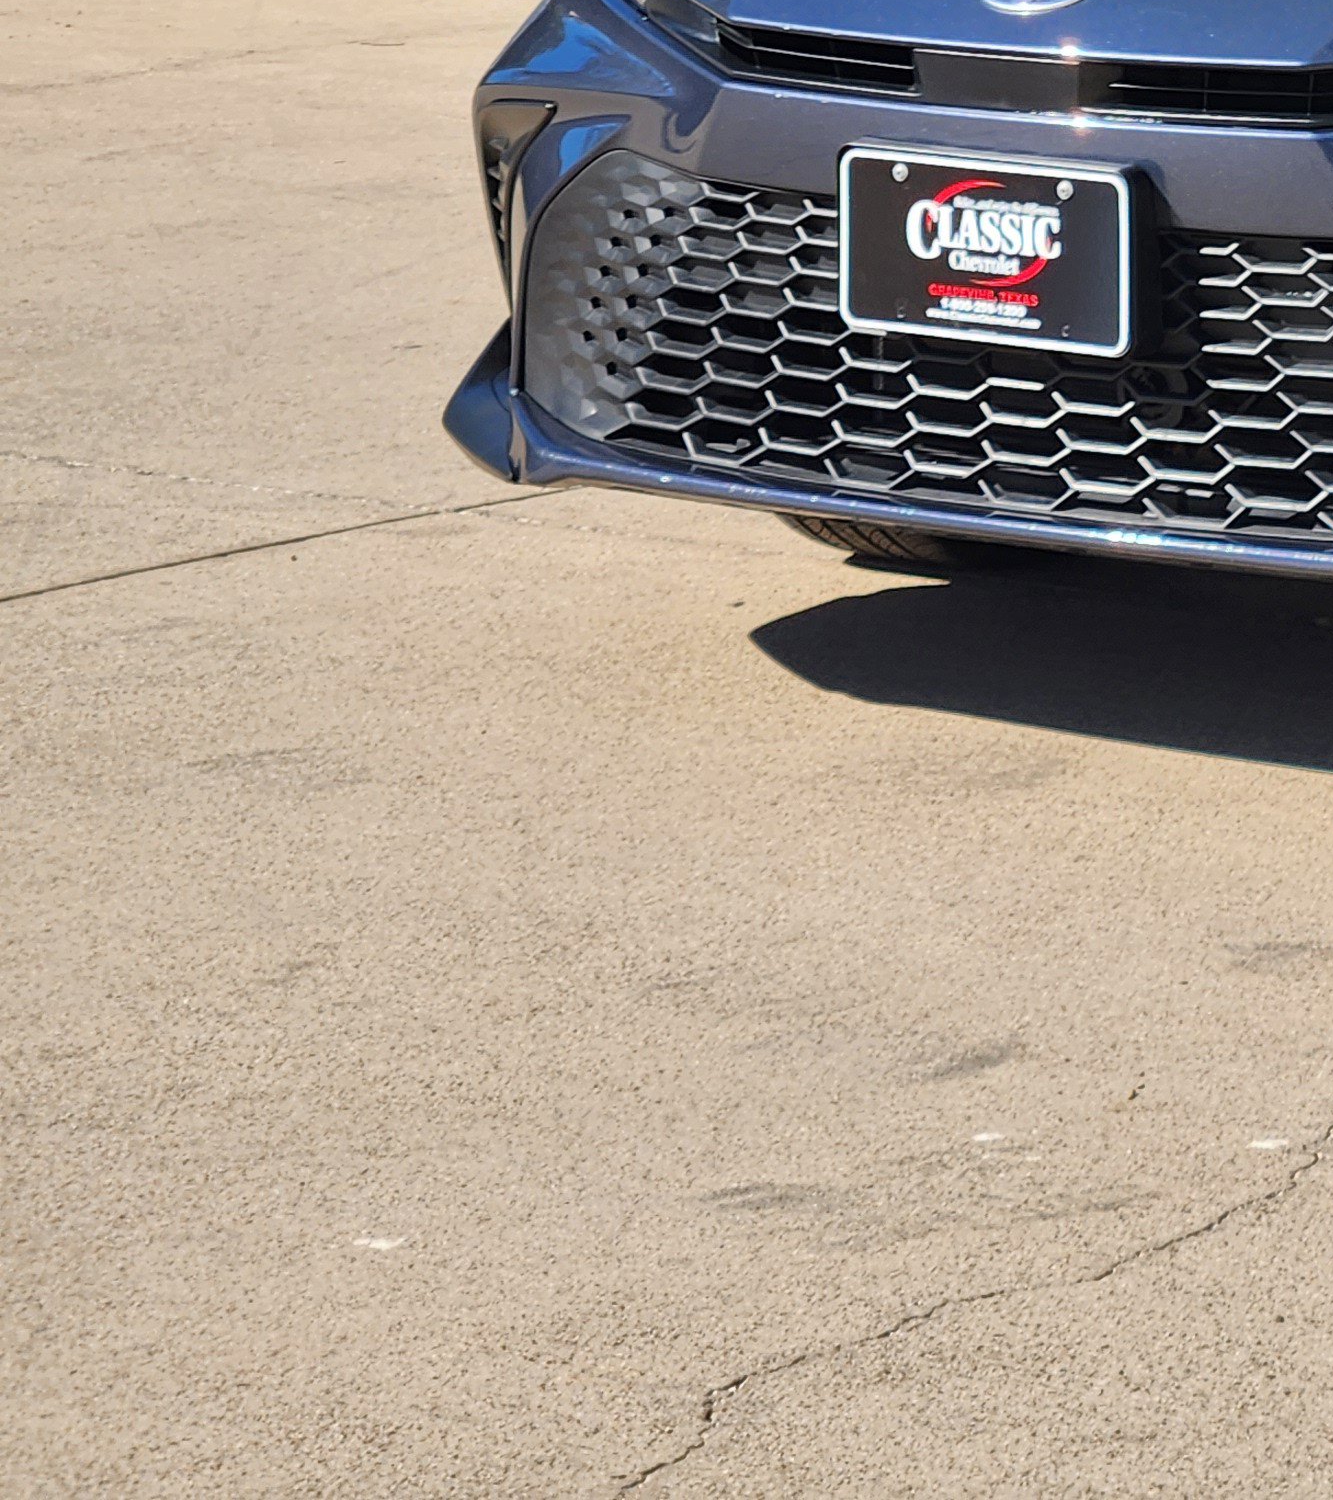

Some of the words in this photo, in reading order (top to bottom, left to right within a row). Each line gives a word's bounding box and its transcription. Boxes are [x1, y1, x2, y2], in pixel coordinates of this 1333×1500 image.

[905, 199, 1062, 261] CLASSIC
[947, 249, 1021, 277] Chevrolet
[998, 291, 1040, 308] TEXAS
